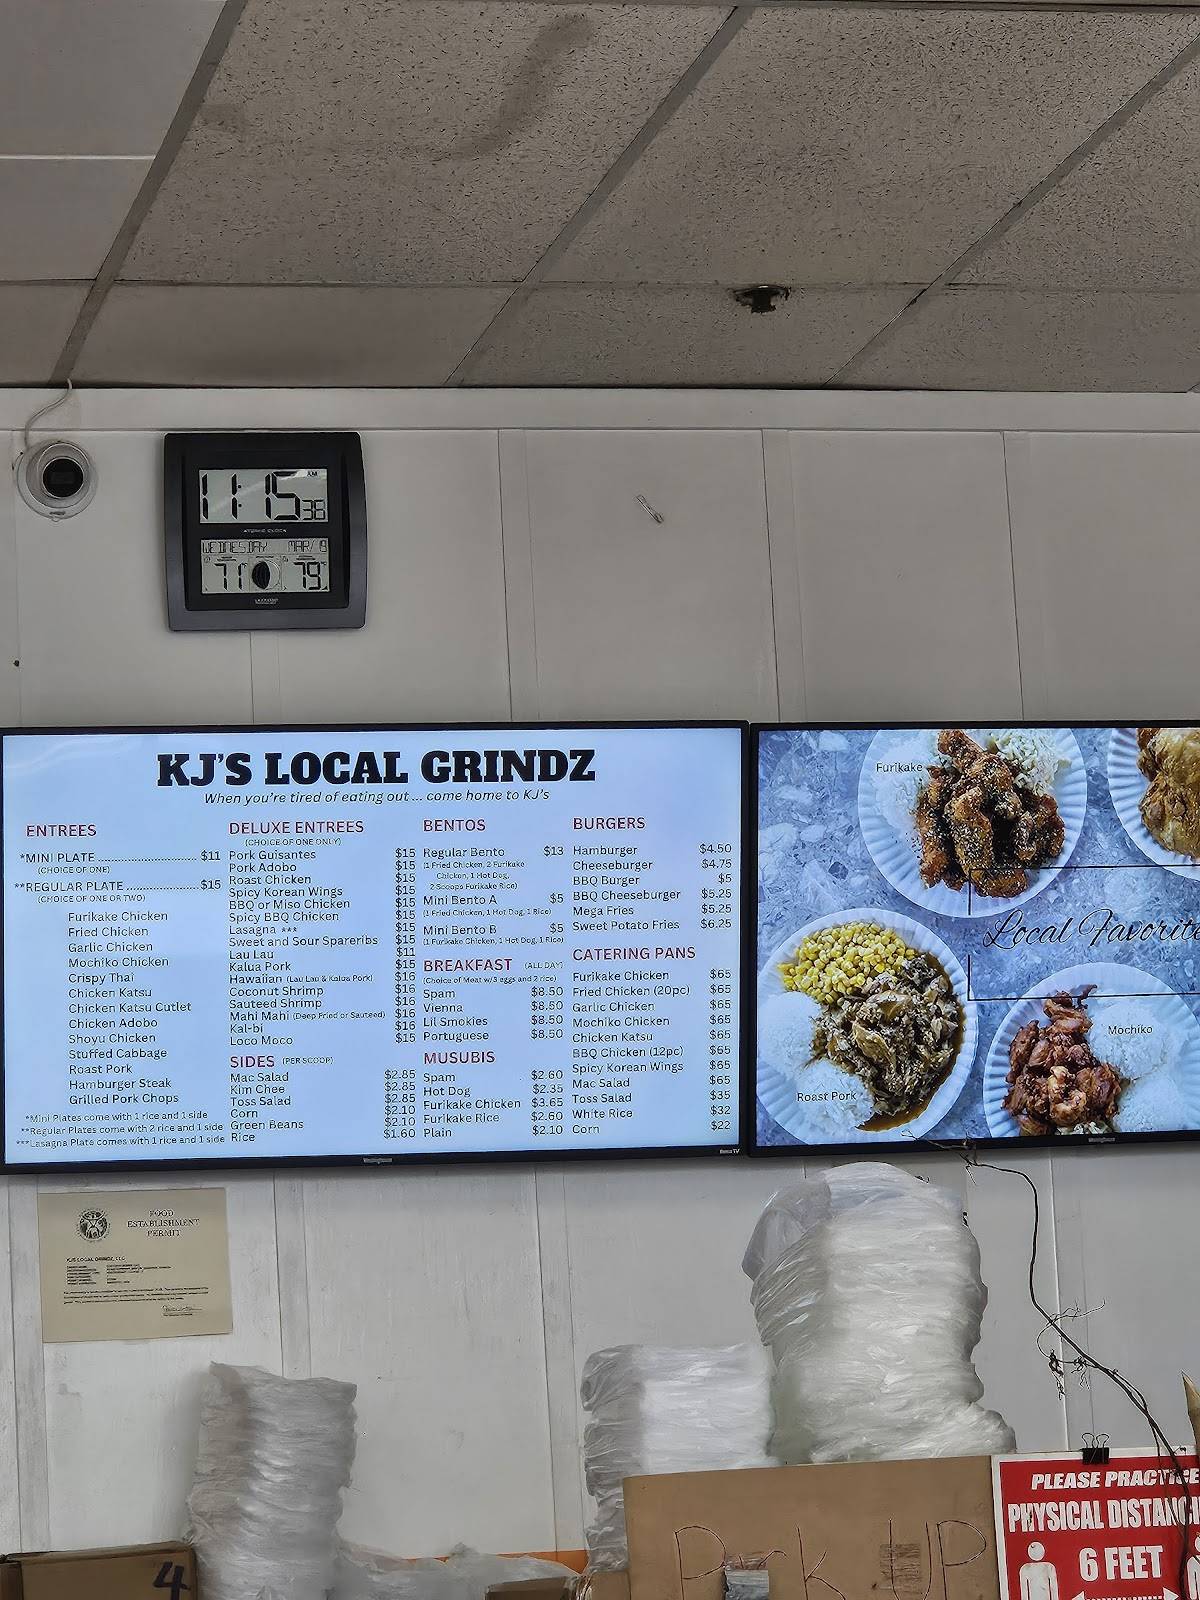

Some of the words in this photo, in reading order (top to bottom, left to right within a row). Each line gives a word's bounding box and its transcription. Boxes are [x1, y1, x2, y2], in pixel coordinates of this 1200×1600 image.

[202, 471, 300, 520] 11:15
[202, 541, 268, 554] WEDNESDAY
[264, 752, 408, 785] LOCAL
[421, 749, 596, 783] GRINDZ
[875, 762, 923, 774] Furikake
[204, 793, 240, 803] When
[290, 792, 321, 803] tired
[325, 791, 340, 802] of
[342, 791, 383, 804] eating
[426, 792, 461, 801] come
[465, 790, 502, 801] home
[506, 791, 519, 800] to
[230, 822, 291, 834] DELUXE
[295, 821, 364, 833] ENTREES
[423, 819, 486, 832] BENTOS
[573, 817, 646, 830] BURGERS
[26, 824, 97, 837] ENTREES
[57, 852, 95, 862] PLATE
[201, 850, 221, 861] $11
[229, 850, 255, 860] Pork
[258, 850, 316, 860] Guisantes
[395, 848, 416, 858] $15
[423, 848, 467, 860] Regular
[470, 847, 505, 857] Bento
[544, 846, 564, 856] $13
[573, 845, 638, 858] Hamburger
[700, 843, 732, 854] $4.50
[573, 860, 653, 873] Cheeseburger
[702, 858, 732, 869] $4.75
[86, 881, 123, 891] PLATE
[200, 880, 221, 890] $15
[573, 876, 598, 887] BBQ
[602, 876, 640, 887] Burger
[229, 888, 261, 900] Spicy
[264, 887, 305, 897] Korean
[308, 887, 343, 899] Wings
[229, 900, 255, 912] BBQ
[273, 900, 301, 909] Miso
[304, 899, 351, 909] Chicken
[68, 912, 117, 922] Furikake
[121, 911, 168, 921] Chicken
[229, 925, 276, 937] Lasagna
[572, 921, 608, 931] Sweet
[611, 921, 649, 930] Potato
[652, 920, 680, 930] Fries
[700, 918, 732, 929] $6.25
[983, 909, 1074, 949] Local
[229, 937, 264, 947] Sweet
[268, 937, 289, 946] and
[292, 937, 320, 946] Sour
[323, 936, 378, 948] Spareribs
[229, 950, 250, 960] Lau
[253, 950, 274, 959] Lau
[396, 947, 416, 957] $11
[573, 948, 651, 960] CATERING
[655, 947, 696, 960] PANS
[68, 957, 118, 968] Mochiko
[122, 957, 169, 967] Chicken
[424, 959, 513, 972] BREAKFAST
[68, 973, 106, 986] Crispy
[109, 972, 134, 982] Thai
[230, 974, 282, 984] Hawaiian
[230, 987, 279, 997] Coconut
[282, 986, 324, 998] Shrimp
[573, 987, 601, 997] Fried
[605, 986, 650, 996] Chicken
[654, 986, 690, 997] (20pc)
[710, 984, 731, 994] $65
[68, 1003, 116, 1014] Chicken
[120, 1002, 152, 1012] Katsu
[155, 1001, 192, 1012] Cutlet
[423, 1003, 463, 1013] Vienna
[531, 1000, 564, 1011] $8.50
[230, 1012, 258, 1021] Mahi
[261, 1011, 289, 1020] Mahi
[68, 1018, 116, 1029] Chicken
[119, 1017, 158, 1028] Adobo
[1107, 1024, 1153, 1035] Mochiko
[68, 1033, 106, 1047] Shoyu
[109, 1032, 156, 1043] Chicken
[423, 1031, 489, 1043] Portuguese
[68, 1048, 113, 1059] Stuffed
[117, 1047, 168, 1061] Cabbage
[424, 1051, 496, 1064] MUSUBIS
[230, 1056, 275, 1068] SIDES
[69, 1079, 135, 1092] Hamburger
[139, 1078, 172, 1088] Steak
[423, 1073, 456, 1085] Spam
[230, 1085, 252, 1094] Kim
[255, 1084, 285, 1094] Chee
[384, 1081, 416, 1092] $2.85
[423, 1087, 445, 1096] Hot
[448, 1086, 471, 1098] Dog
[532, 1084, 563, 1094] $2.35
[69, 1094, 109, 1105] Grilled
[112, 1094, 139, 1104] Pork
[142, 1093, 179, 1106] Chops
[797, 1092, 828, 1102] Roast
[831, 1090, 857, 1101] Pork
[572, 1109, 605, 1119] White
[609, 1109, 633, 1118] Rice
[710, 1105, 731, 1115] $32
[423, 1128, 452, 1138] Plain
[532, 1124, 563, 1135] $2.10
[572, 1124, 600, 1134] Corn
[711, 1120, 731, 1130] $22
[231, 1133, 256, 1142] Rice
[383, 1128, 416, 1139] $1.60
[149, 1209, 174, 1217] FOOD
[127, 1219, 200, 1228] ESTABLISHMENT
[1031, 1472, 1100, 1490] PLEASE
[1105, 1468, 1199, 1487] PRACTICE
[1007, 1501, 1104, 1532] PHYSICAL
[1079, 1548, 1099, 1582] 6
[1104, 1545, 1163, 1580] FEET
[153, 1561, 191, 1600] 4
